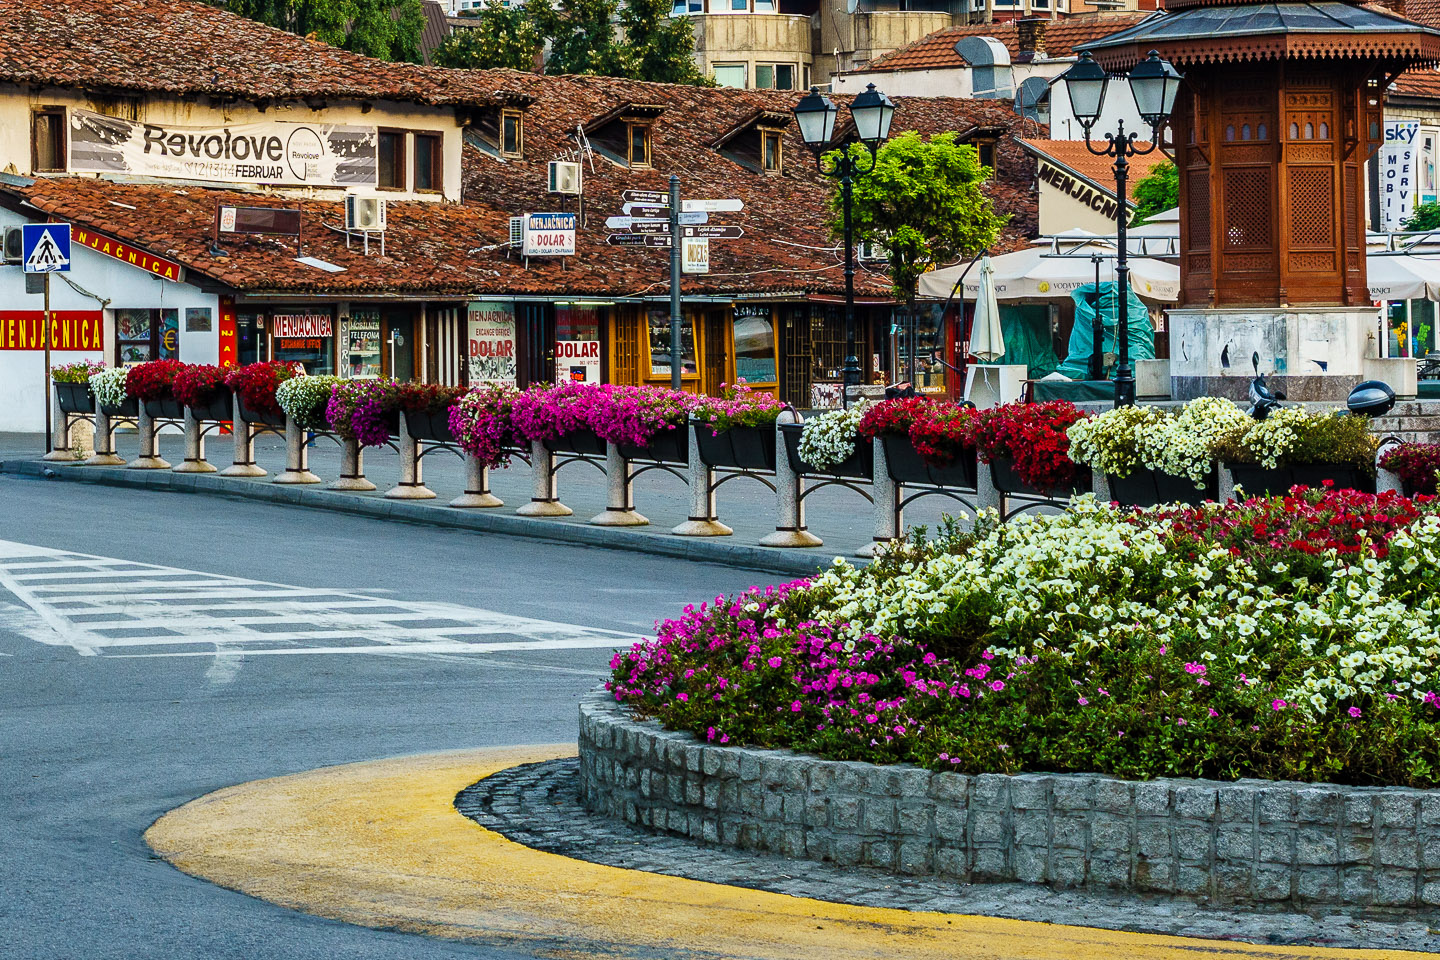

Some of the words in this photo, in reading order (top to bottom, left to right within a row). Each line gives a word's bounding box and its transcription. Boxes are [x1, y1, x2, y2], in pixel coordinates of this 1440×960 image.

[1386, 124, 1418, 144] sky
[235, 165, 283, 179] FEBRUAR
[1386, 155, 1397, 222] MOBIL
[1399, 151, 1411, 227] SERVIS
[529, 215, 574, 229] MENJAČNICA
[537, 234, 565, 247] DOLAR
[350, 331, 379, 340] TELEFONA
[470, 339, 513, 357] DOLAR
[555, 342, 599, 358] DOLAR
